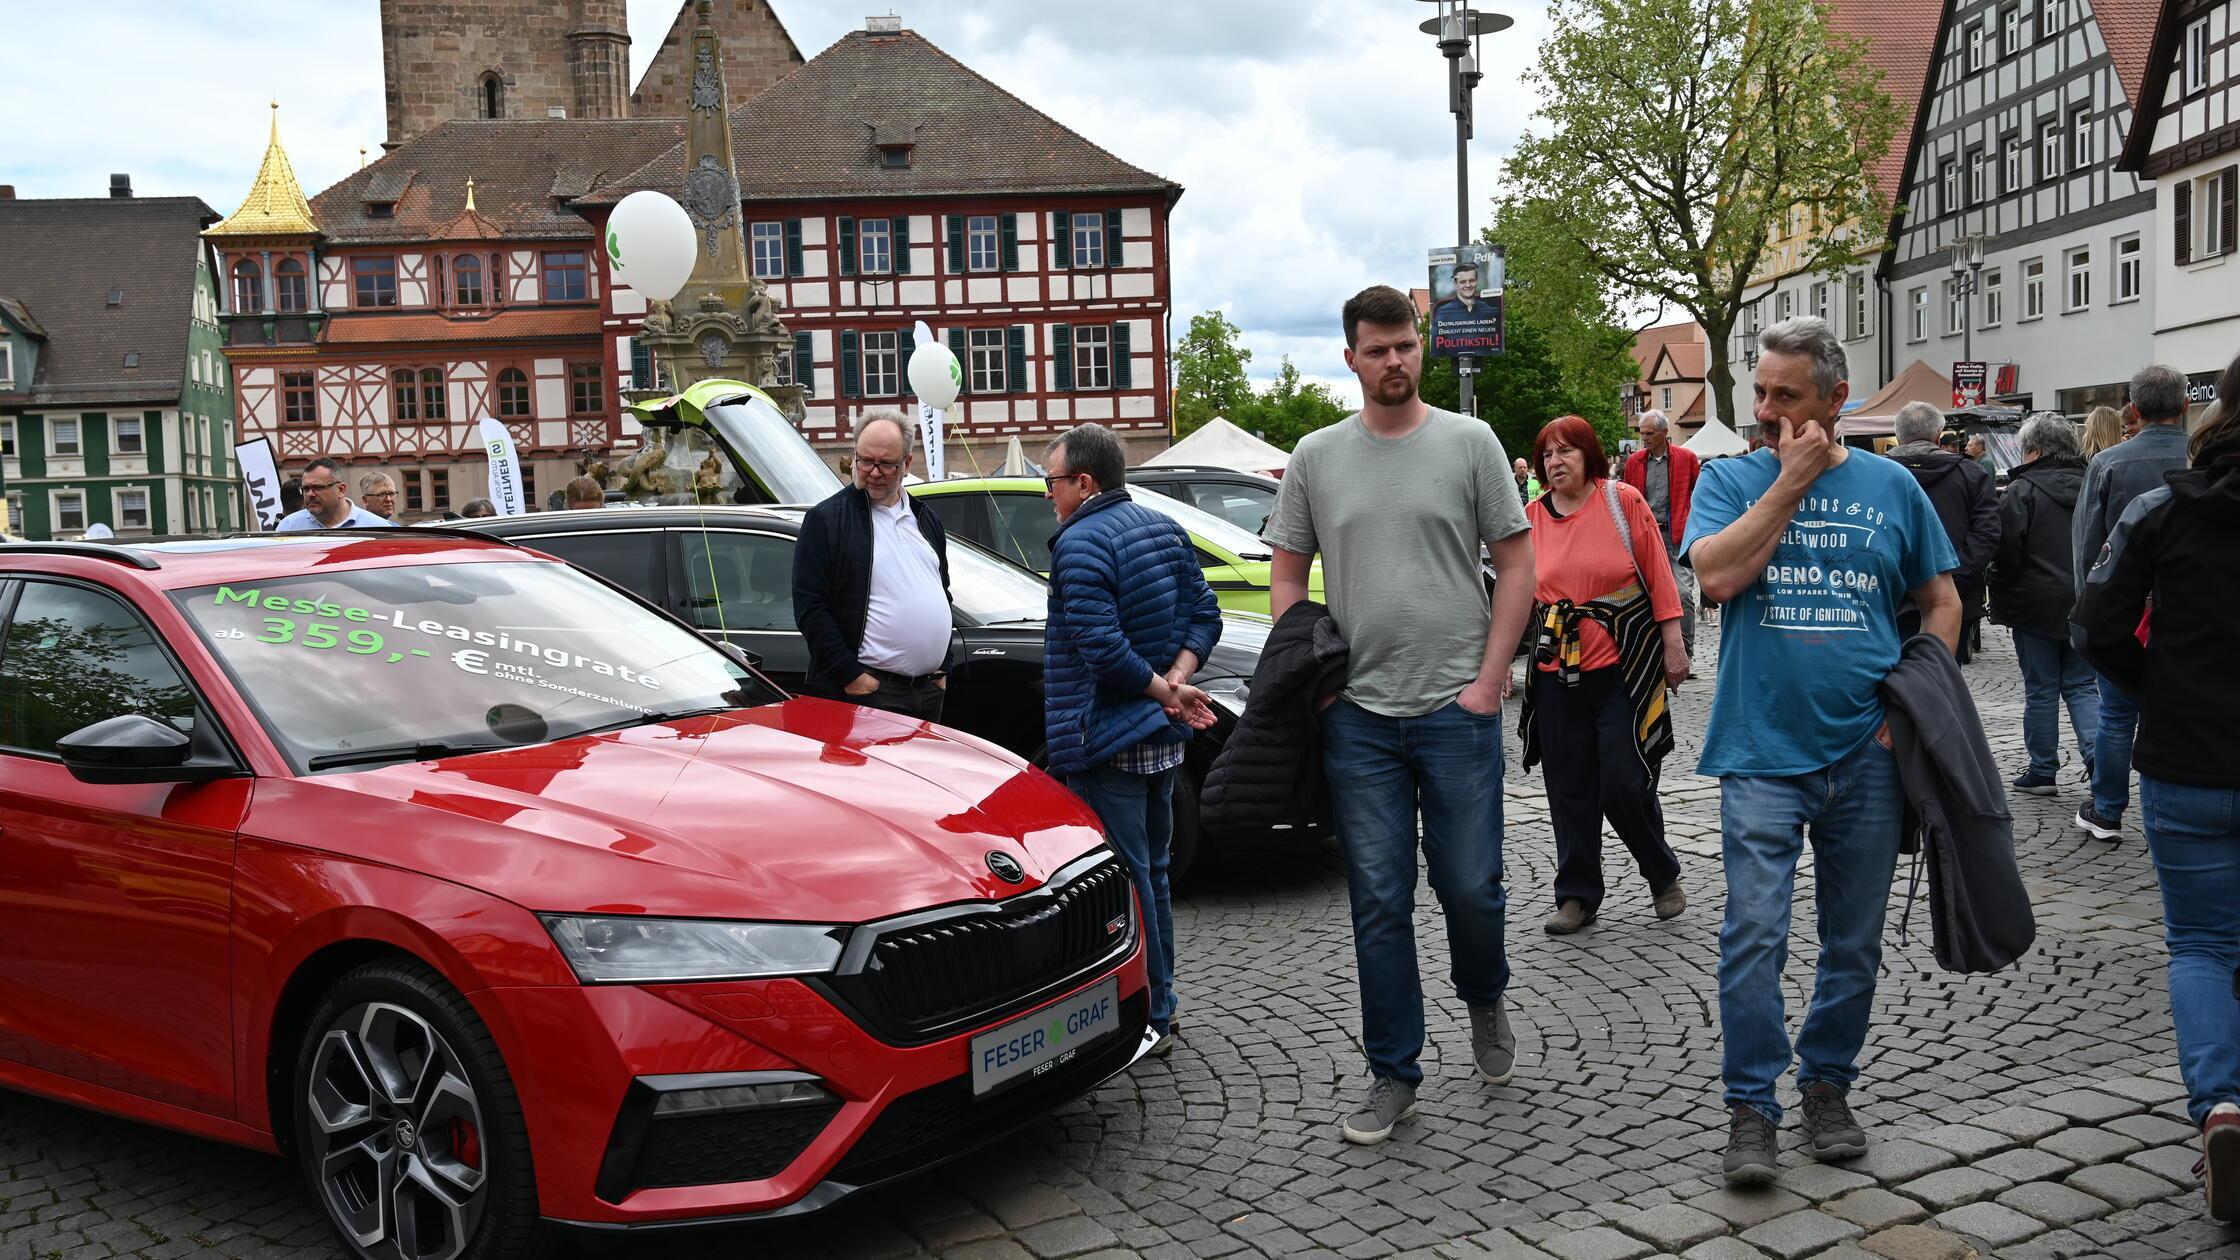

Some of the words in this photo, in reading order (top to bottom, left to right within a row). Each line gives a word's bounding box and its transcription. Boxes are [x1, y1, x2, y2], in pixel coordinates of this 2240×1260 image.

[1436, 334, 1499, 349] POLITIKSTIL!
[1769, 606, 1796, 621] STATE
[1799, 607, 1812, 621] OF
[1815, 608, 1857, 623] IGNITION
[213, 586, 661, 691] Messe-Leasingrate
[214, 628, 245, 640] ab
[450, 649, 490, 675] €
[494, 671, 535, 685] ohne
[984, 1028, 1045, 1073] FESER
[1066, 997, 1109, 1035] GRAF
[1033, 1060, 1053, 1077] FESER
[1059, 1049, 1076, 1064] GRAF
